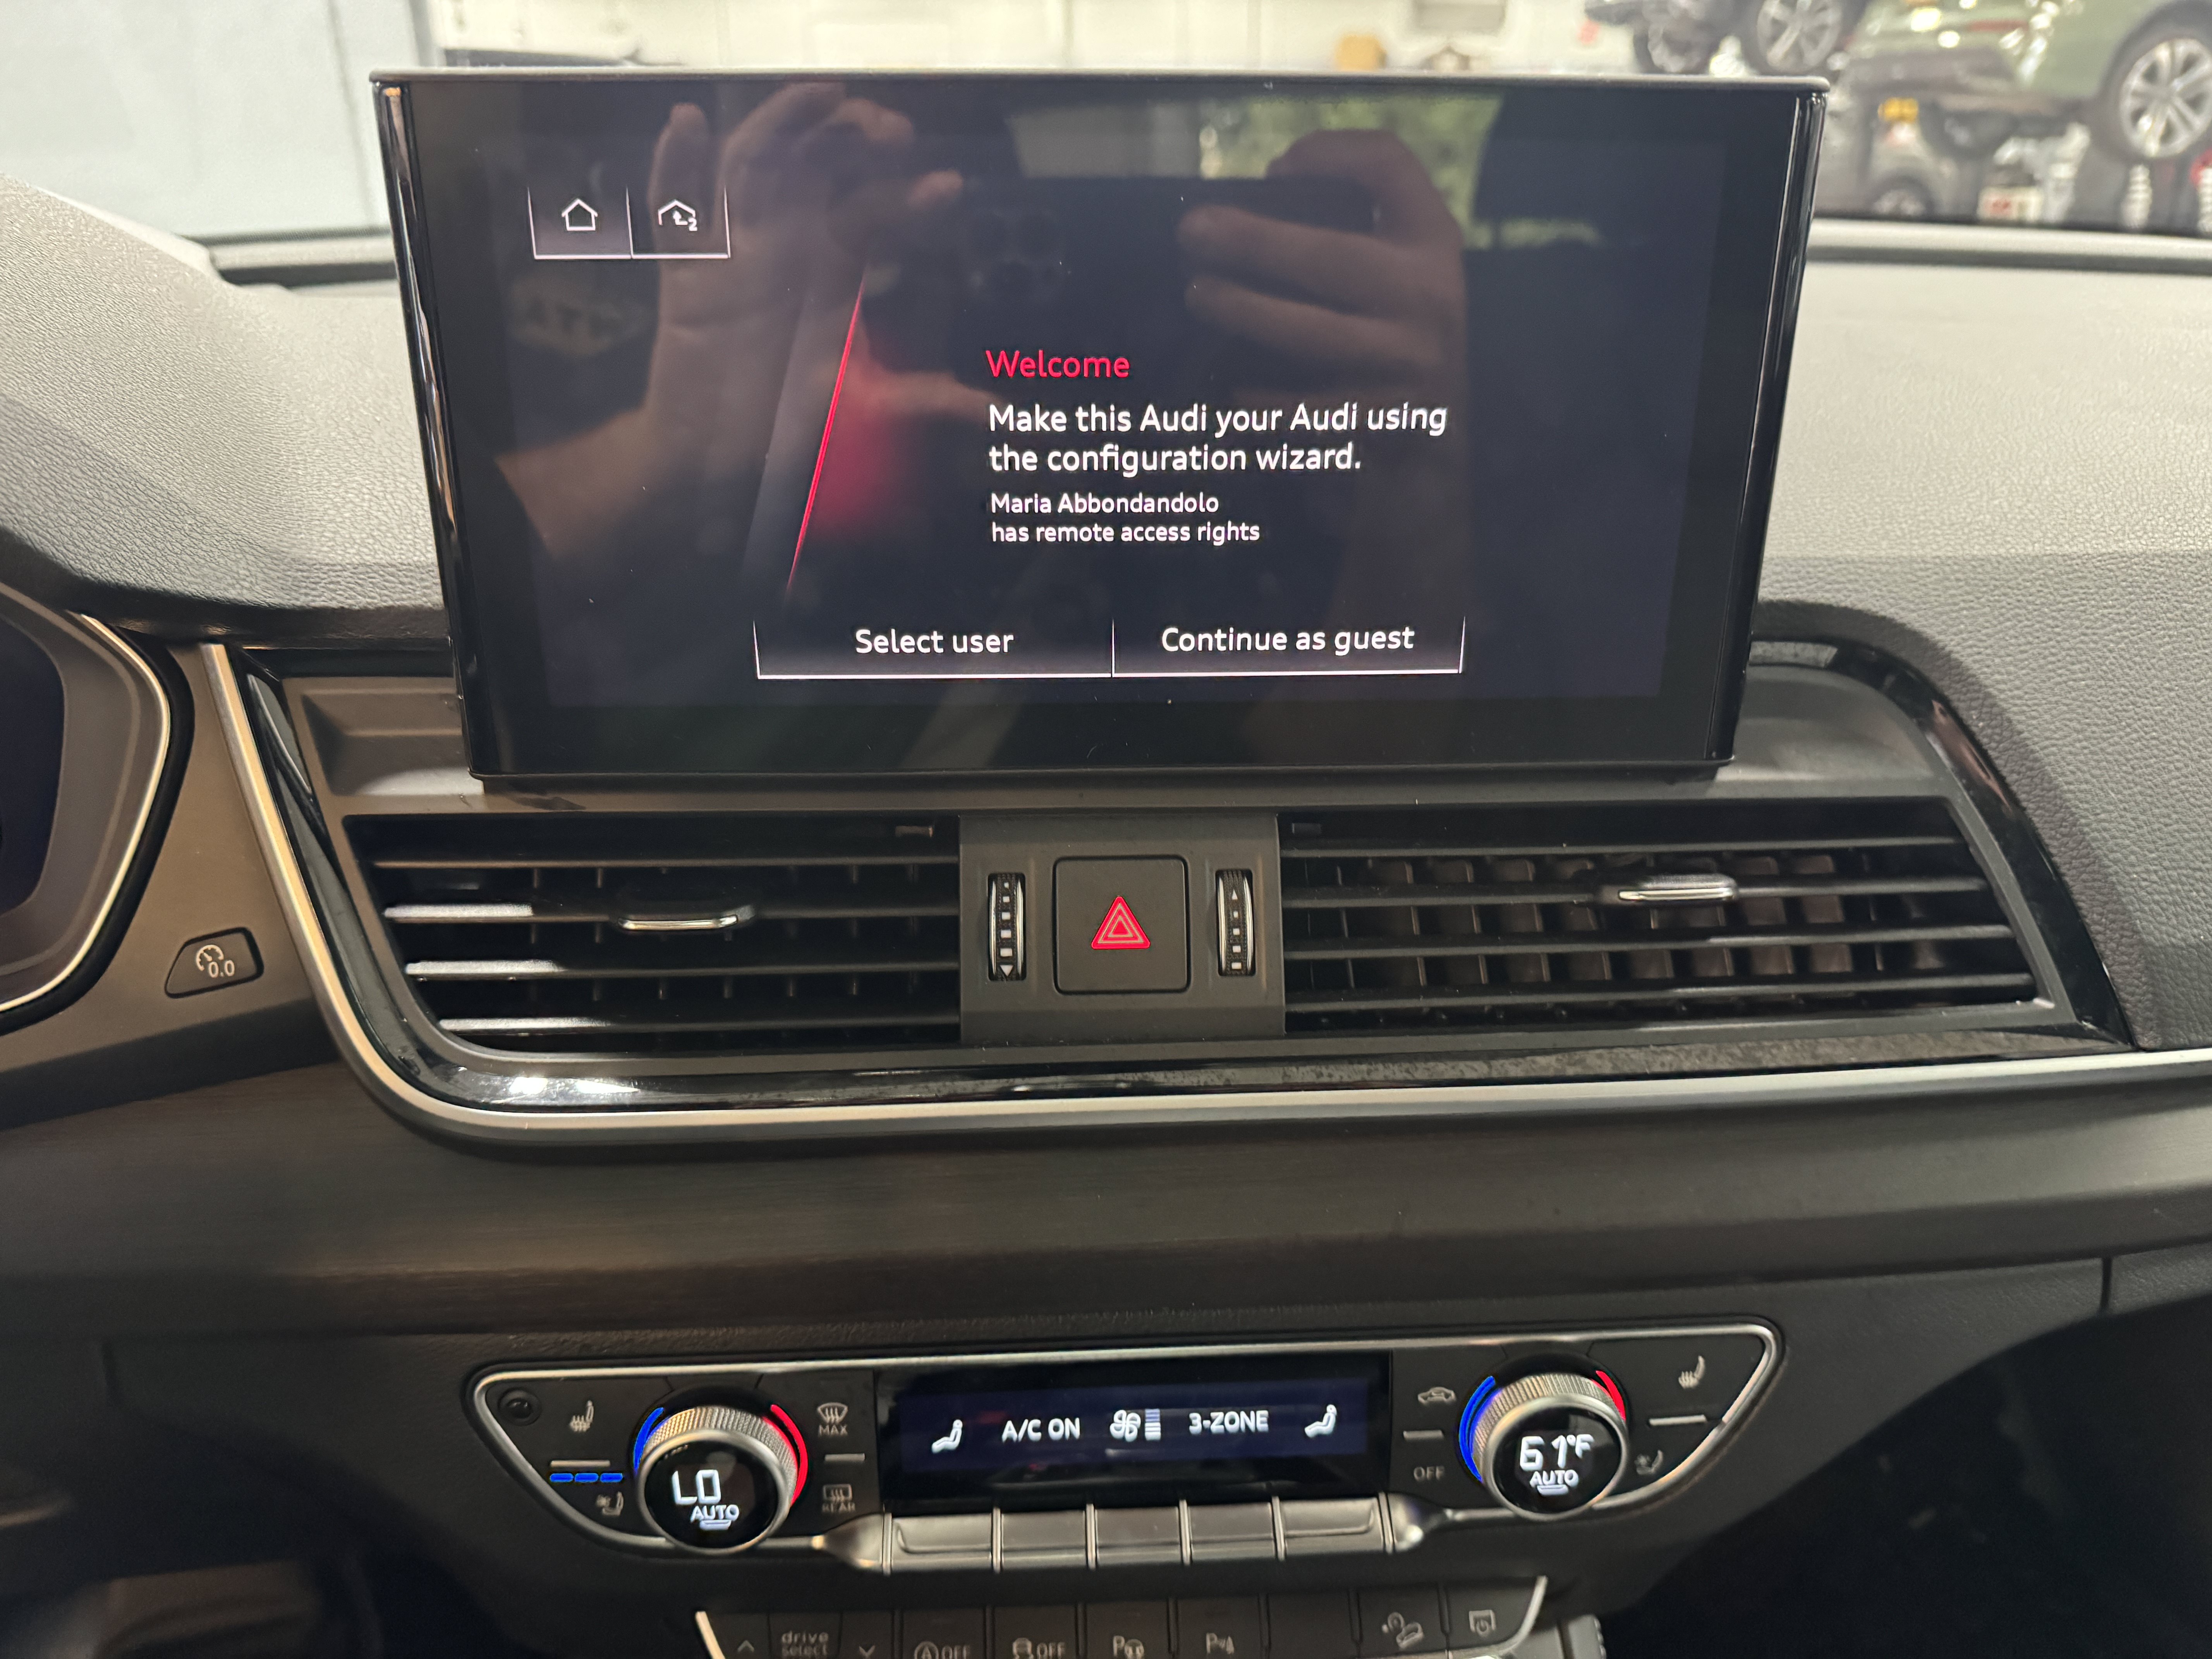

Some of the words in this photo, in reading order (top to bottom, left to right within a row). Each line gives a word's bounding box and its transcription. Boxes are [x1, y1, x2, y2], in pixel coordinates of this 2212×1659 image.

[985, 349, 1130, 378] Welcome
[989, 404, 1067, 432] Make
[1075, 404, 1132, 432] this
[1139, 403, 1207, 432] Audi
[1214, 409, 1283, 438] your
[1290, 401, 1358, 431] Audi
[1367, 401, 1448, 436] using
[988, 443, 1038, 472] the
[1047, 443, 1247, 478] configuration
[1255, 441, 1362, 470] wizard.
[991, 493, 1052, 514] Maria
[1057, 491, 1219, 514] Abbondandolo
[992, 521, 1030, 542] has
[1036, 523, 1115, 542] remote
[1120, 526, 1191, 542] access
[1197, 520, 1261, 546] rights
[855, 628, 944, 654] Select
[952, 634, 1014, 653] user
[1161, 627, 1288, 652] Continue
[1295, 631, 1326, 651] as
[1334, 626, 1416, 656] guest
[208, 960, 235, 978] 0.0
[818, 1425, 848, 1436] MAX
[1001, 1418, 1042, 1442] A/C
[1047, 1417, 1081, 1440] ON
[1188, 1409, 1269, 1435] 3-ZONE
[1413, 1466, 1445, 1482] OFF
[1529, 1469, 1579, 1488] AUTO
[672, 1469, 721, 1505] LO
[689, 1504, 740, 1523] AUTO
[821, 1503, 855, 1513] REAR
[781, 1630, 829, 1644] drive
[781, 1645, 828, 1658] select
[1036, 1641, 1066, 1659] OFF
